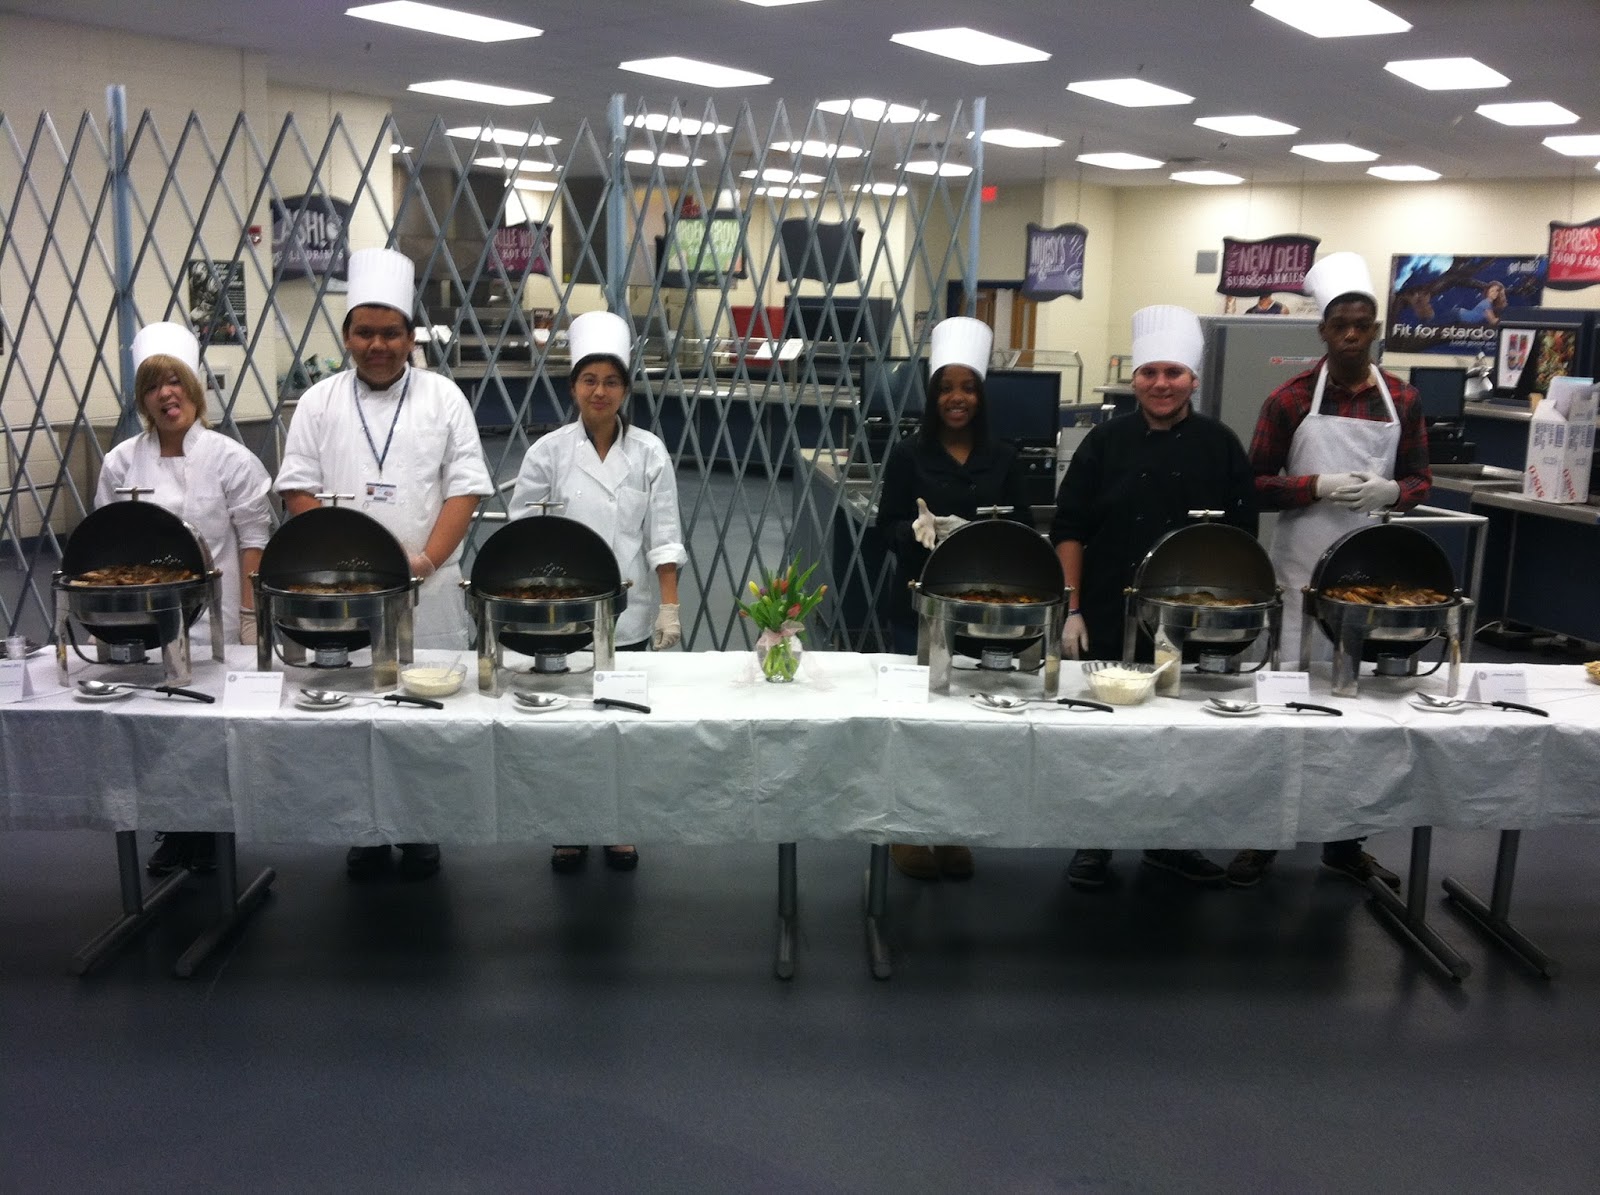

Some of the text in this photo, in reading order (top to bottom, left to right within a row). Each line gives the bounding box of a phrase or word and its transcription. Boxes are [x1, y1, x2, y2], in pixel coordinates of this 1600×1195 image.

[1237, 244, 1273, 274] NEW
[1577, 253, 1600, 269] FAS
[1226, 275, 1250, 287] SUBS
[1392, 323, 1498, 341] Fit for stardo
